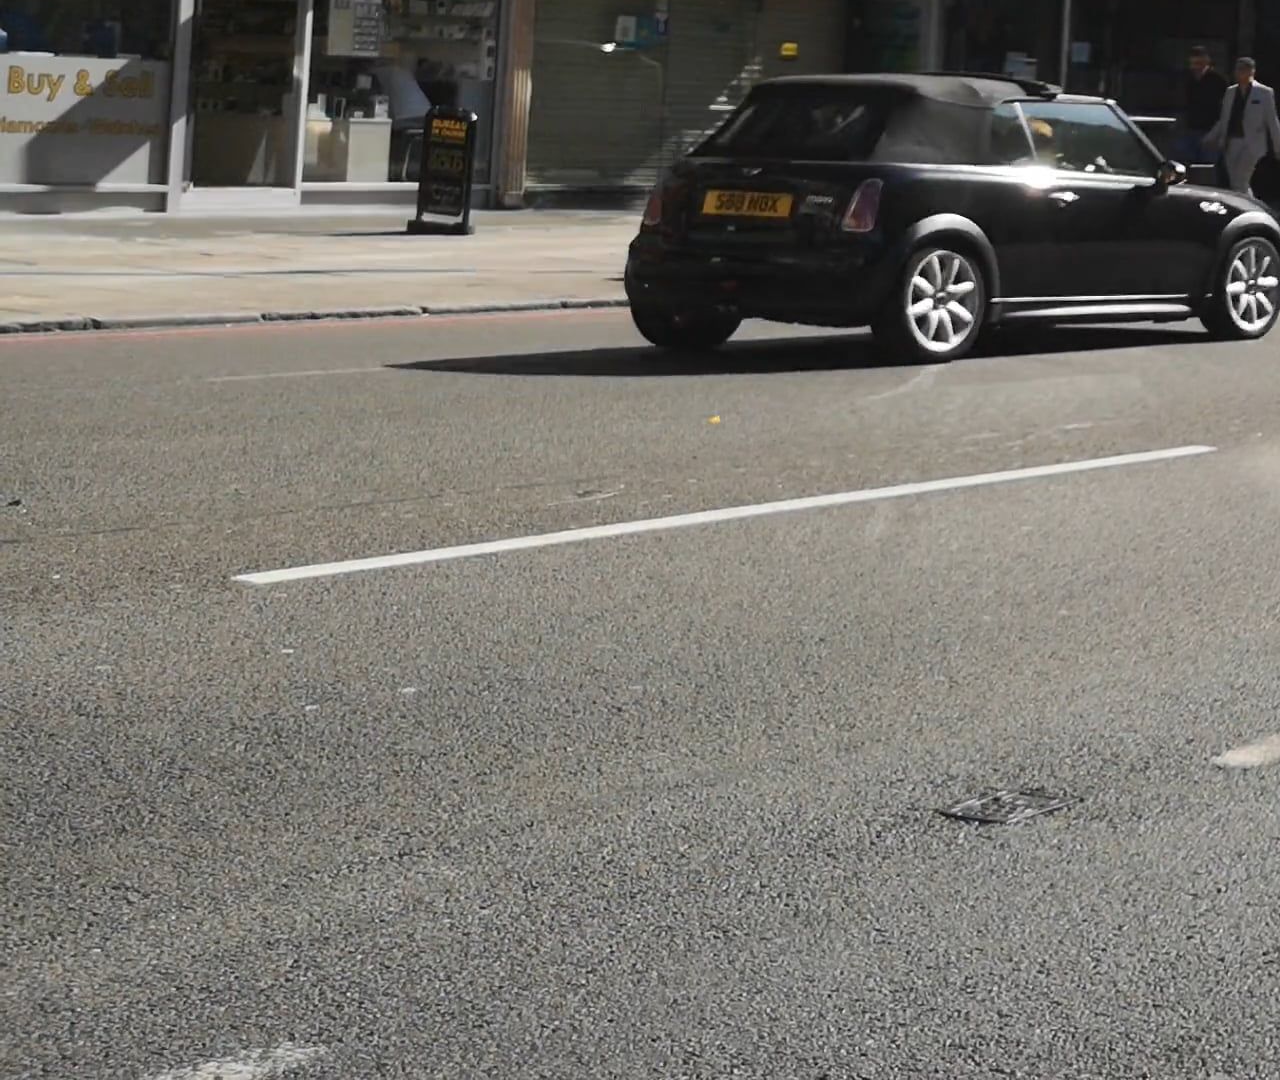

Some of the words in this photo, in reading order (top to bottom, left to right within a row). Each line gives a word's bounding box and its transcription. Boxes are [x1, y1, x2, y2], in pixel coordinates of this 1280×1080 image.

[7, 65, 65, 102] Buy
[73, 69, 94, 96] &
[104, 69, 153, 98] Sell
